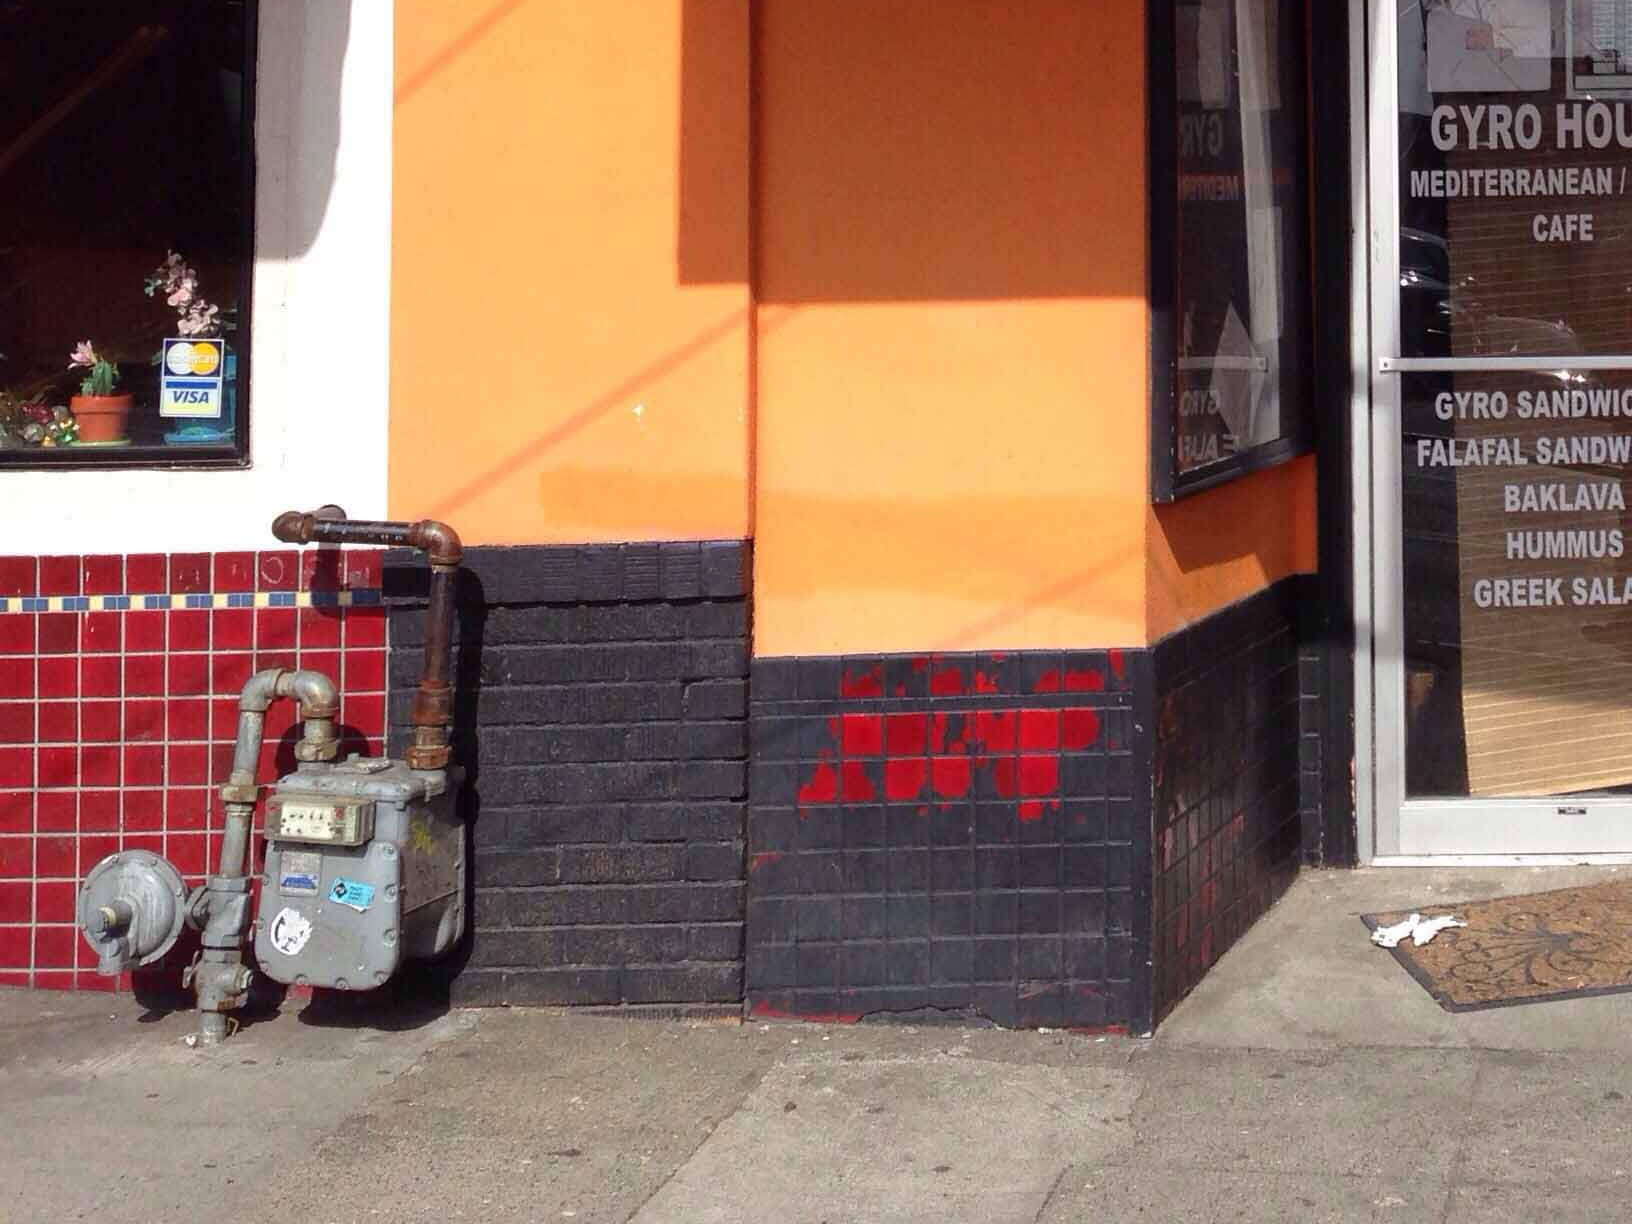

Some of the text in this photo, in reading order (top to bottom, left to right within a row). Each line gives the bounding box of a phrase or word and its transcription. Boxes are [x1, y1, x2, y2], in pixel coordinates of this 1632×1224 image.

[1431, 104, 1542, 150] GYRO
[1410, 167, 1613, 198] MEDITERRANEAN
[1532, 213, 1594, 242] CAFE
[172, 390, 209, 403] VISA
[1435, 392, 1508, 420] GYRO
[1417, 437, 1529, 467] FALAFAL
[1504, 482, 1626, 513] BAKLAVA
[1506, 529, 1625, 560] HUMMUS
[1474, 578, 1564, 608] GREEK
